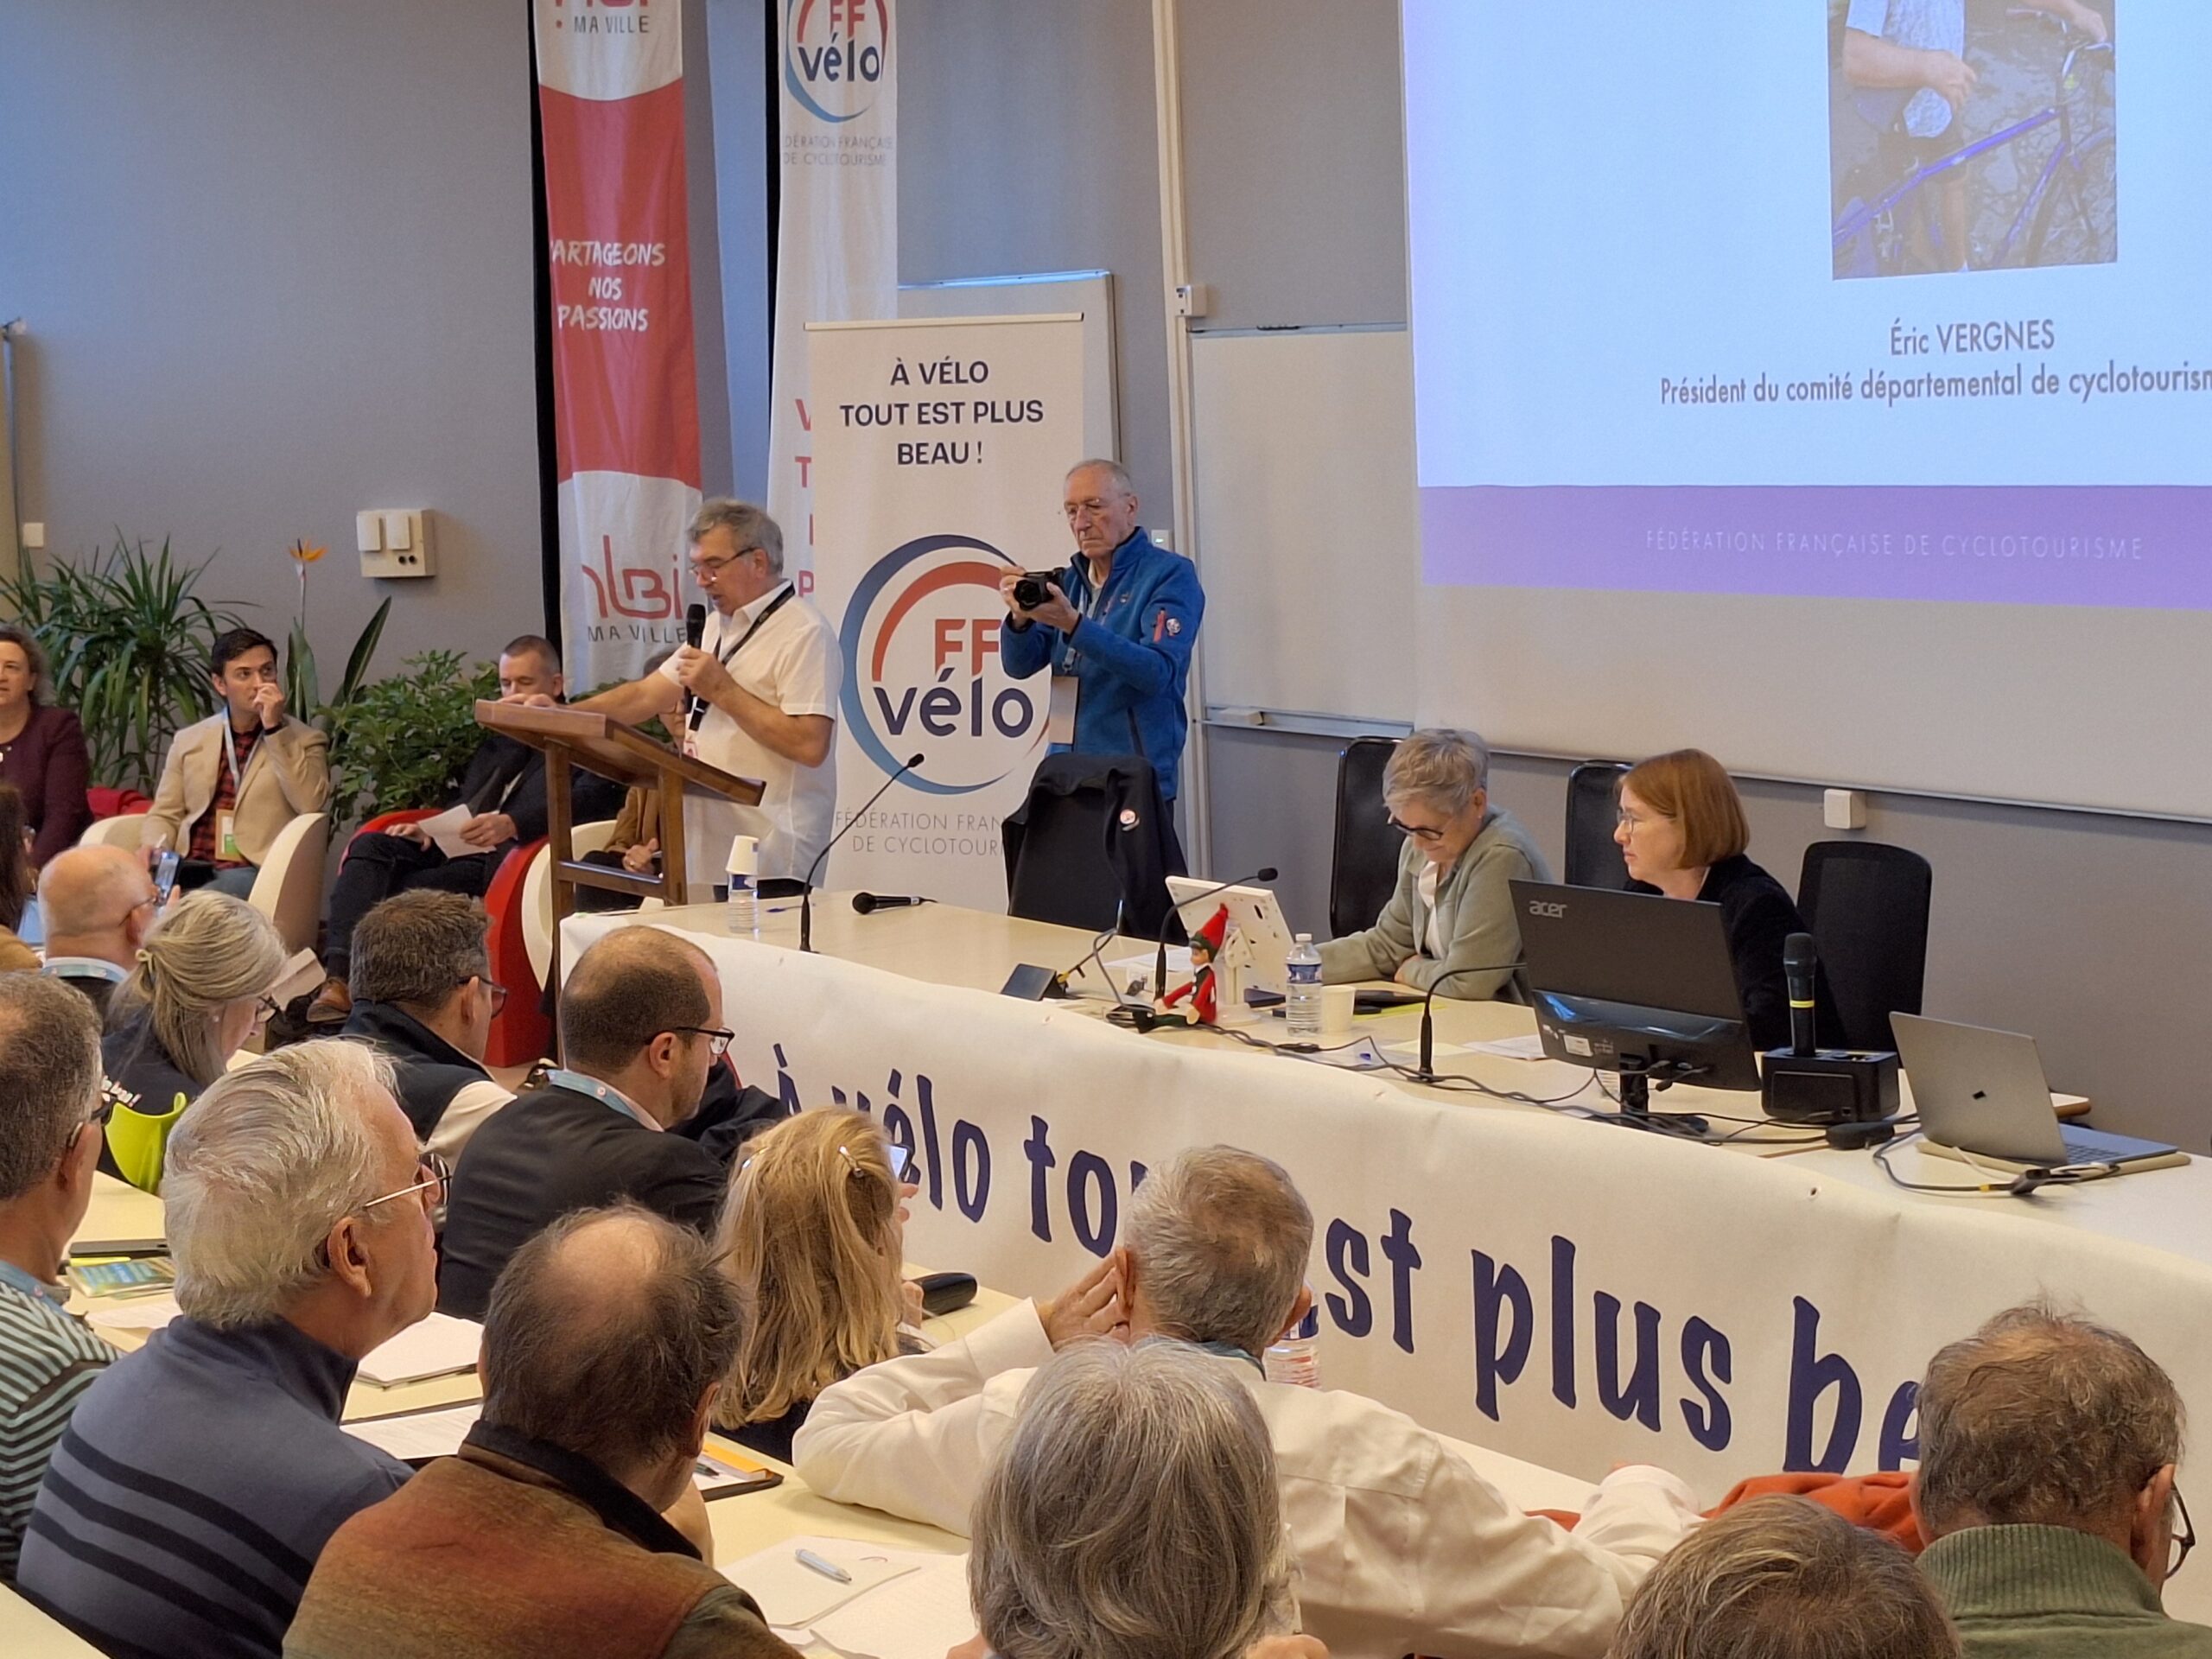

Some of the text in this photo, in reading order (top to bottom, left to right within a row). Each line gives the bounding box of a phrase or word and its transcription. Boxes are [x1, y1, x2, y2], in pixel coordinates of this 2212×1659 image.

[575, 16, 650, 34] MA VILLE
[830, 0, 867, 39] FF
[798, 32, 880, 81] vélo
[550, 238, 666, 267] ARTAGEONS
[588, 276, 622, 301] NOS
[557, 304, 649, 332] PASSIONS
[1890, 318, 2055, 355] Éric VERGNES
[890, 355, 989, 385] À VÉLO
[1660, 374, 1746, 404] Président
[1753, 372, 1779, 402] du
[1786, 372, 1853, 401] comité
[1860, 363, 2023, 407] départemental
[2031, 363, 2060, 394] de
[840, 403, 910, 427] TOUT
[918, 402, 965, 425] EST
[974, 399, 1044, 423] PLUS
[1646, 528, 2143, 560] FÉDÉRATION FRANÇAISE DE CYCLOTOURISME
[588, 625, 687, 643] MA VILLE
[935, 619, 1002, 676] FF
[873, 668, 1034, 737] vélo
[836, 807, 1005, 832] FÉDÉRATION FRAN
[853, 836, 874, 852] DE
[1529, 900, 1567, 918] acer
[831, 1068, 991, 1222] élo
[1325, 1208, 1421, 1353] st
[1471, 1235, 1732, 1452] plus
[1783, 1296, 1920, 1475] be
